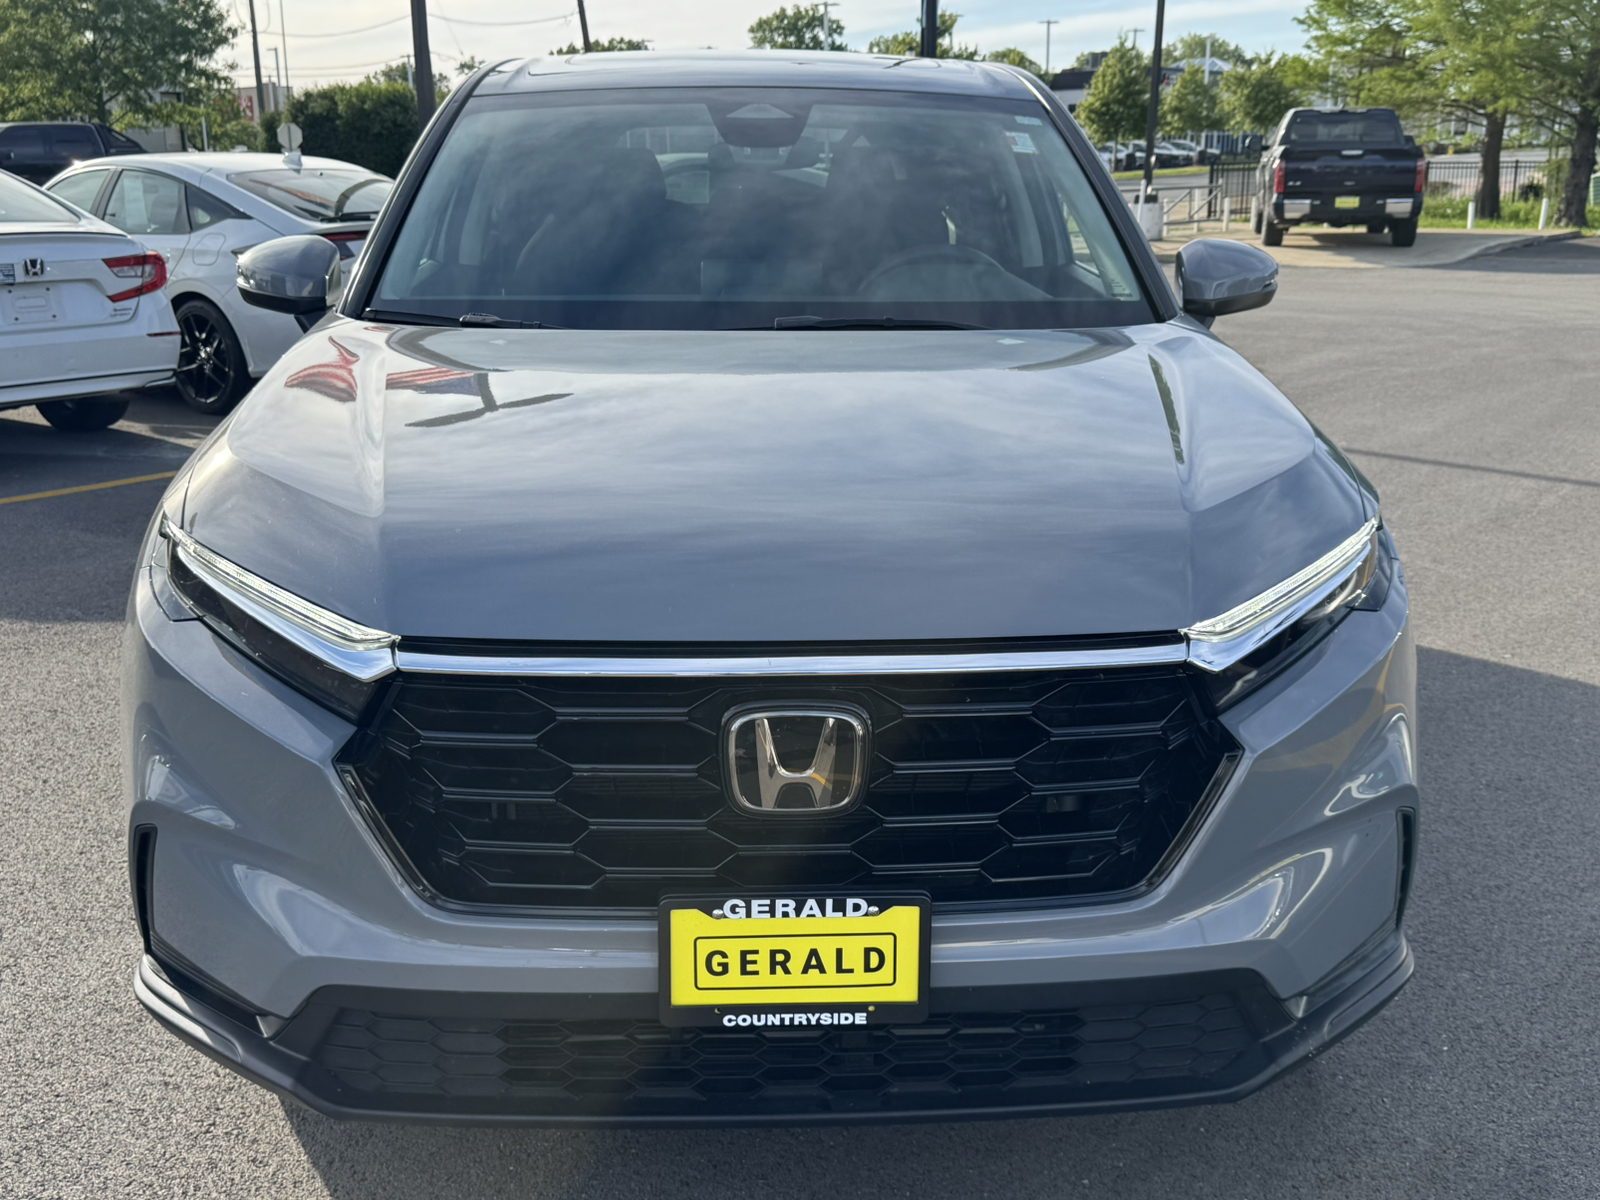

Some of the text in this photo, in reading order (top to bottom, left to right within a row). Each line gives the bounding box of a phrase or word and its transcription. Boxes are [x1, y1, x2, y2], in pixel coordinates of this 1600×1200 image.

[722, 898, 869, 919] GERALD
[704, 947, 886, 977] GERALD
[722, 1012, 867, 1027] COUNTRYSIDE
